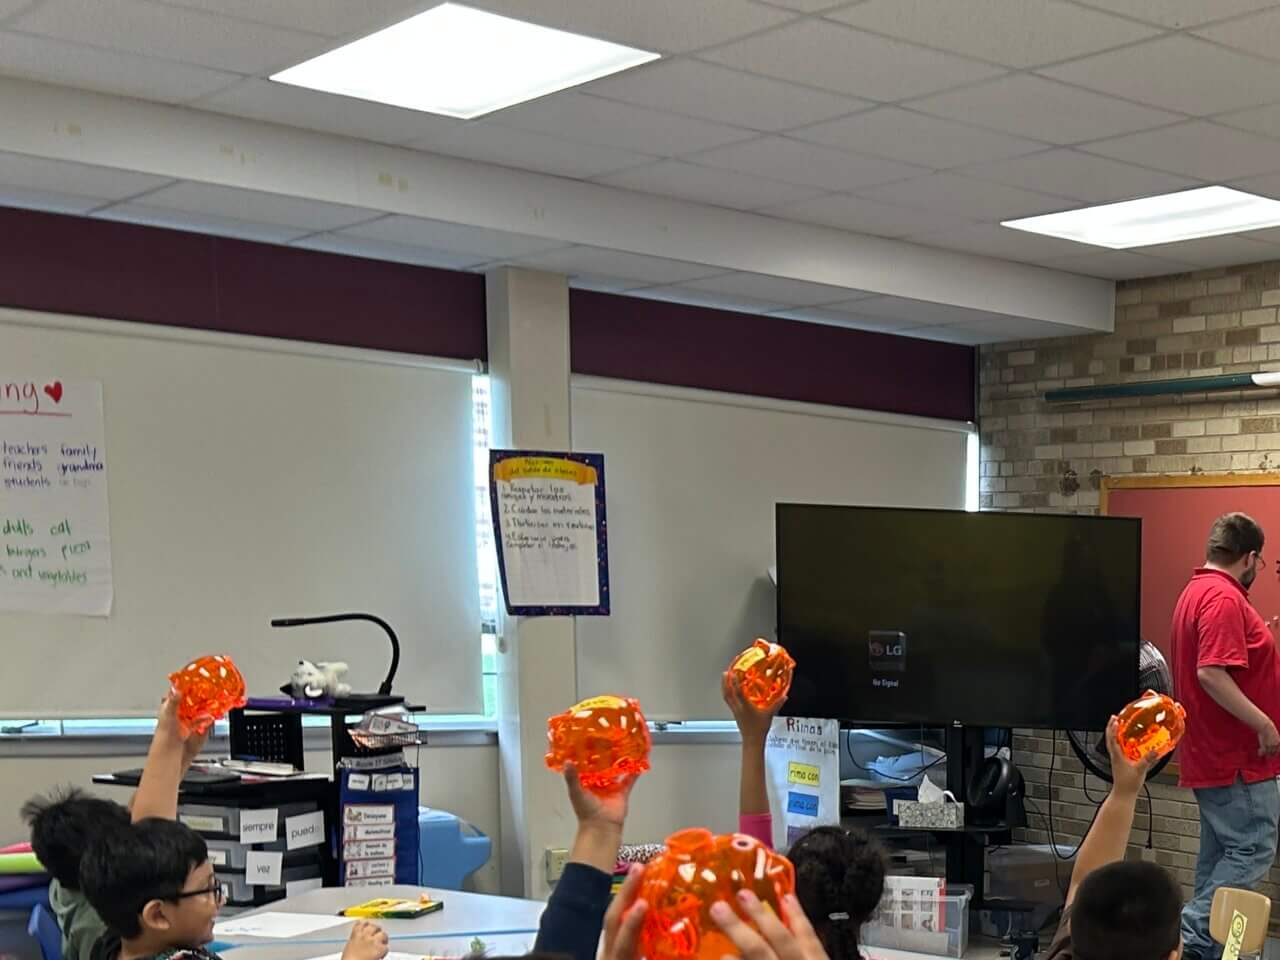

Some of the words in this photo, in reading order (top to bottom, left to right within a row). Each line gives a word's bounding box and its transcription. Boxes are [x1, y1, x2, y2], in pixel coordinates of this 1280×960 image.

[885, 644, 902, 656] LG
[786, 717, 823, 735] Rimas
[242, 820, 275, 835] siempre
[256, 863, 271, 875] vez
